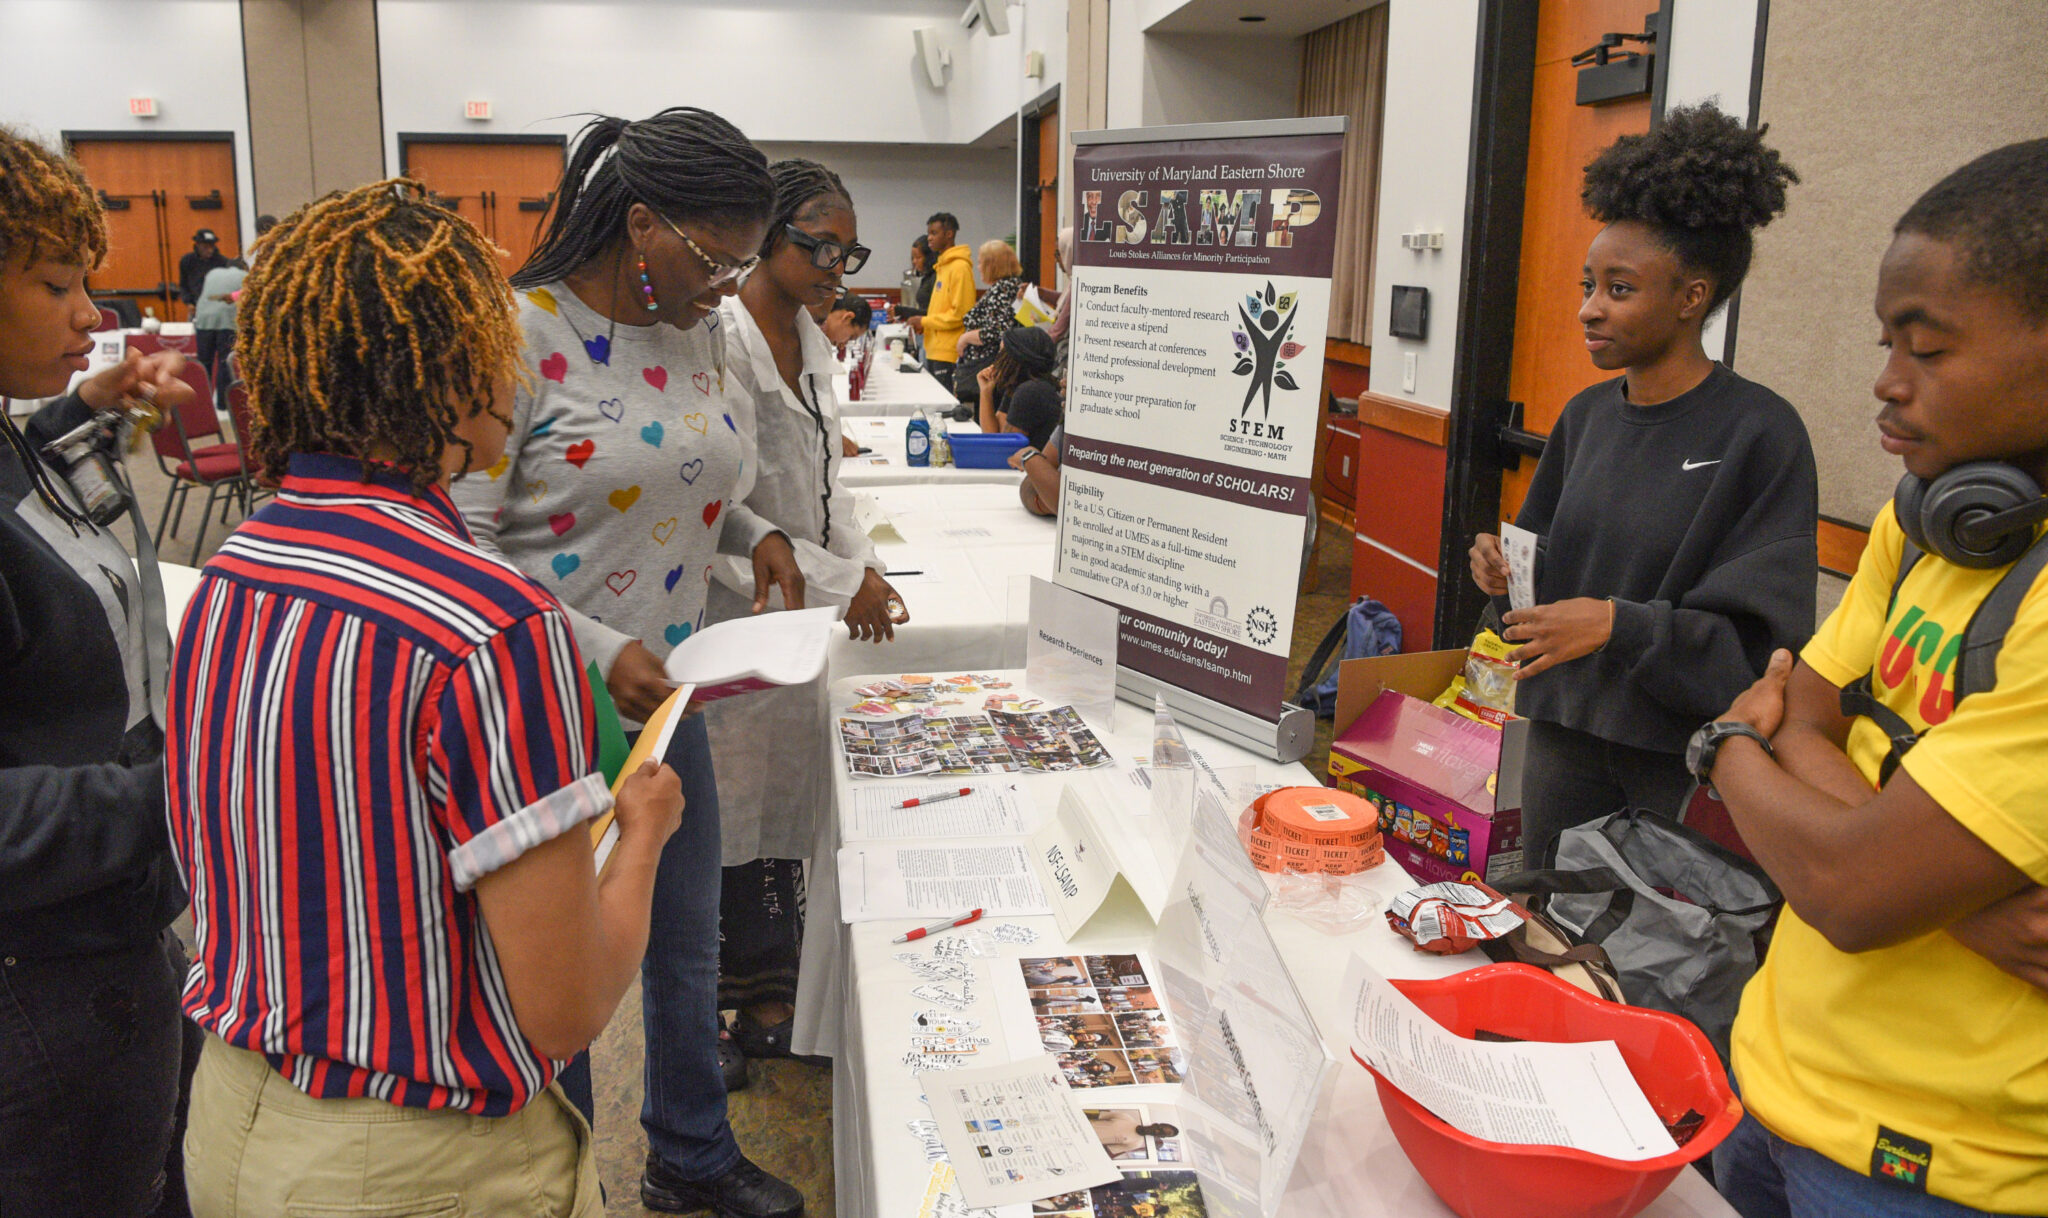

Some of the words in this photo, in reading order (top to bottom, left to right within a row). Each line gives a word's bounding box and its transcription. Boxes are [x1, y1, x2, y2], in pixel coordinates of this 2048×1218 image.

[129, 98, 152, 114] EXIT
[467, 101, 488, 116] EXIT
[1091, 168, 1145, 185] University
[1149, 167, 1160, 181] of
[1163, 166, 1217, 184] Maryland
[1221, 165, 1265, 179] Eastern
[1268, 163, 1305, 179] Shore
[1080, 188, 1321, 248] LSAMP
[1109, 249, 1127, 259] Louis
[1128, 250, 1149, 260] Stokes
[1151, 251, 1181, 261] Alliances
[1182, 252, 1192, 261] for
[1193, 252, 1223, 265] Minority
[1225, 253, 1270, 265] Participation
[1080, 282, 1111, 296] Program
[1114, 284, 1148, 296] Benefits
[1086, 300, 1119, 313] Conduct
[1121, 303, 1191, 319] faculty-mentored
[1193, 310, 1230, 321] research
[1085, 318, 1099, 327] and
[1101, 321, 1129, 330] receive
[1138, 323, 1168, 335] stipend
[1084, 334, 1111, 346] Present
[1114, 338, 1147, 351] research
[1149, 343, 1157, 352] at
[1159, 343, 1206, 357] conferences
[1083, 352, 1108, 363] Attend
[1111, 355, 1160, 370] professional
[1162, 361, 1216, 377] development
[1082, 368, 1124, 384] workshops
[1081, 385, 1112, 399] Enhance
[1114, 392, 1133, 403] your
[1135, 394, 1182, 409] preparation
[1184, 399, 1196, 411] for
[1080, 402, 1113, 415] graduate
[1115, 407, 1140, 419] school
[1230, 419, 1284, 440] STEM
[1220, 434, 1244, 444] SCIENCE
[1248, 439, 1293, 452] TECHNOLOGY
[1224, 445, 1263, 457] ENGINEERING
[1268, 452, 1287, 461] MATH
[1068, 445, 1107, 466] Preparing
[1110, 453, 1125, 466] the
[1127, 458, 1148, 471] next
[1150, 463, 1200, 482] generation
[1202, 472, 1214, 485] of
[1215, 474, 1296, 501] SCHOLARS!
[1068, 481, 1104, 499] Eligibility
[1074, 500, 1083, 511] Be
[1084, 504, 1089, 512] a
[1107, 508, 1135, 523] Citizen
[1136, 516, 1145, 526] or
[1147, 517, 1190, 538] Permanent
[1191, 528, 1228, 547] Resident
[1073, 516, 1082, 527] Be
[1083, 519, 1115, 536] enrolled
[1116, 529, 1124, 537] at
[1125, 530, 1150, 545] UMES
[1151, 538, 1160, 547] as
[1161, 541, 1166, 549] a
[1167, 541, 1203, 558] full-time
[1204, 553, 1236, 568] student
[1072, 534, 1105, 551] majoring
[1105, 542, 1114, 552] in
[1115, 546, 1120, 554] a
[1121, 545, 1145, 560] STEM
[1146, 553, 1185, 572] discipline
[1071, 549, 1080, 560] Be
[1081, 552, 1089, 561] in
[1090, 554, 1109, 569] good
[1111, 560, 1147, 580] academic
[1148, 570, 1182, 592] standing
[1184, 581, 1202, 596] with
[1205, 588, 1210, 597] a
[1070, 565, 1110, 585] cumulative
[1111, 577, 1130, 590] GPA
[1131, 583, 1140, 593] of
[1140, 585, 1152, 597] 3.0
[1153, 590, 1162, 600] or
[1163, 591, 1189, 609] higher
[1194, 616, 1220, 630] EASTERN
[1221, 625, 1241, 637] SHORE
[1251, 619, 1272, 633] NSF
[1133, 616, 1191, 648] community
[1193, 636, 1228, 658] today!
[1039, 629, 1065, 649] Research
[1066, 641, 1103, 666] Experiences
[1120, 631, 1252, 685] www.umes.edu/sans/lsamp.html
[1251, 834, 1271, 849] TICKET
[1283, 827, 1302, 841] TICKET
[1314, 837, 1339, 846] TICKET
[1351, 832, 1369, 843] TICKET
[1251, 852, 1266, 860] KEEP
[1285, 846, 1310, 857] TICKET
[1324, 851, 1348, 859] TICKET
[1361, 841, 1378, 856] TICKET
[1046, 845, 1078, 899] NSF-LSAMP
[1425, 858, 1458, 881] flavor
